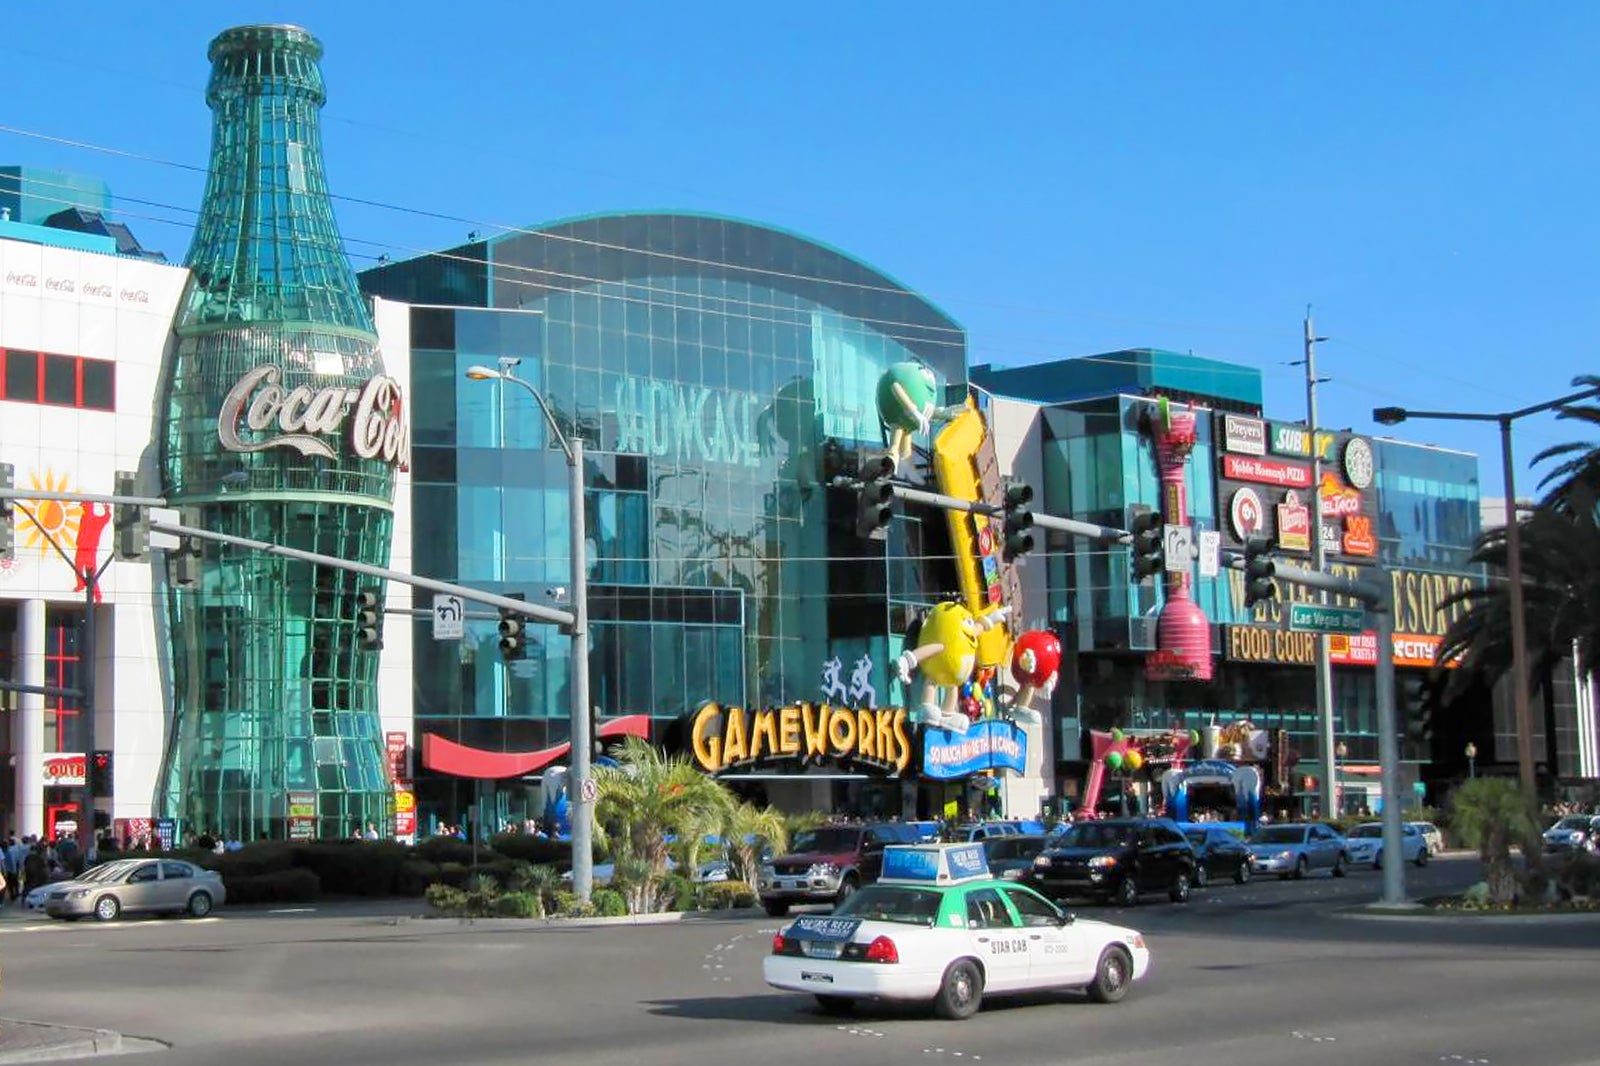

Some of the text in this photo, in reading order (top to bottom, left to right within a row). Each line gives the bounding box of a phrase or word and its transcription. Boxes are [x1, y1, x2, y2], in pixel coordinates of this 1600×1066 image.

[1275, 427, 1334, 459] SUBWY
[1294, 610, 1312, 625] Las
[1391, 570, 1472, 635] ESORTS
[1231, 627, 1317, 663] FOOD COUR
[691, 701, 913, 772] GAMEWORKS
[991, 939, 1028, 954] STAR CAB
